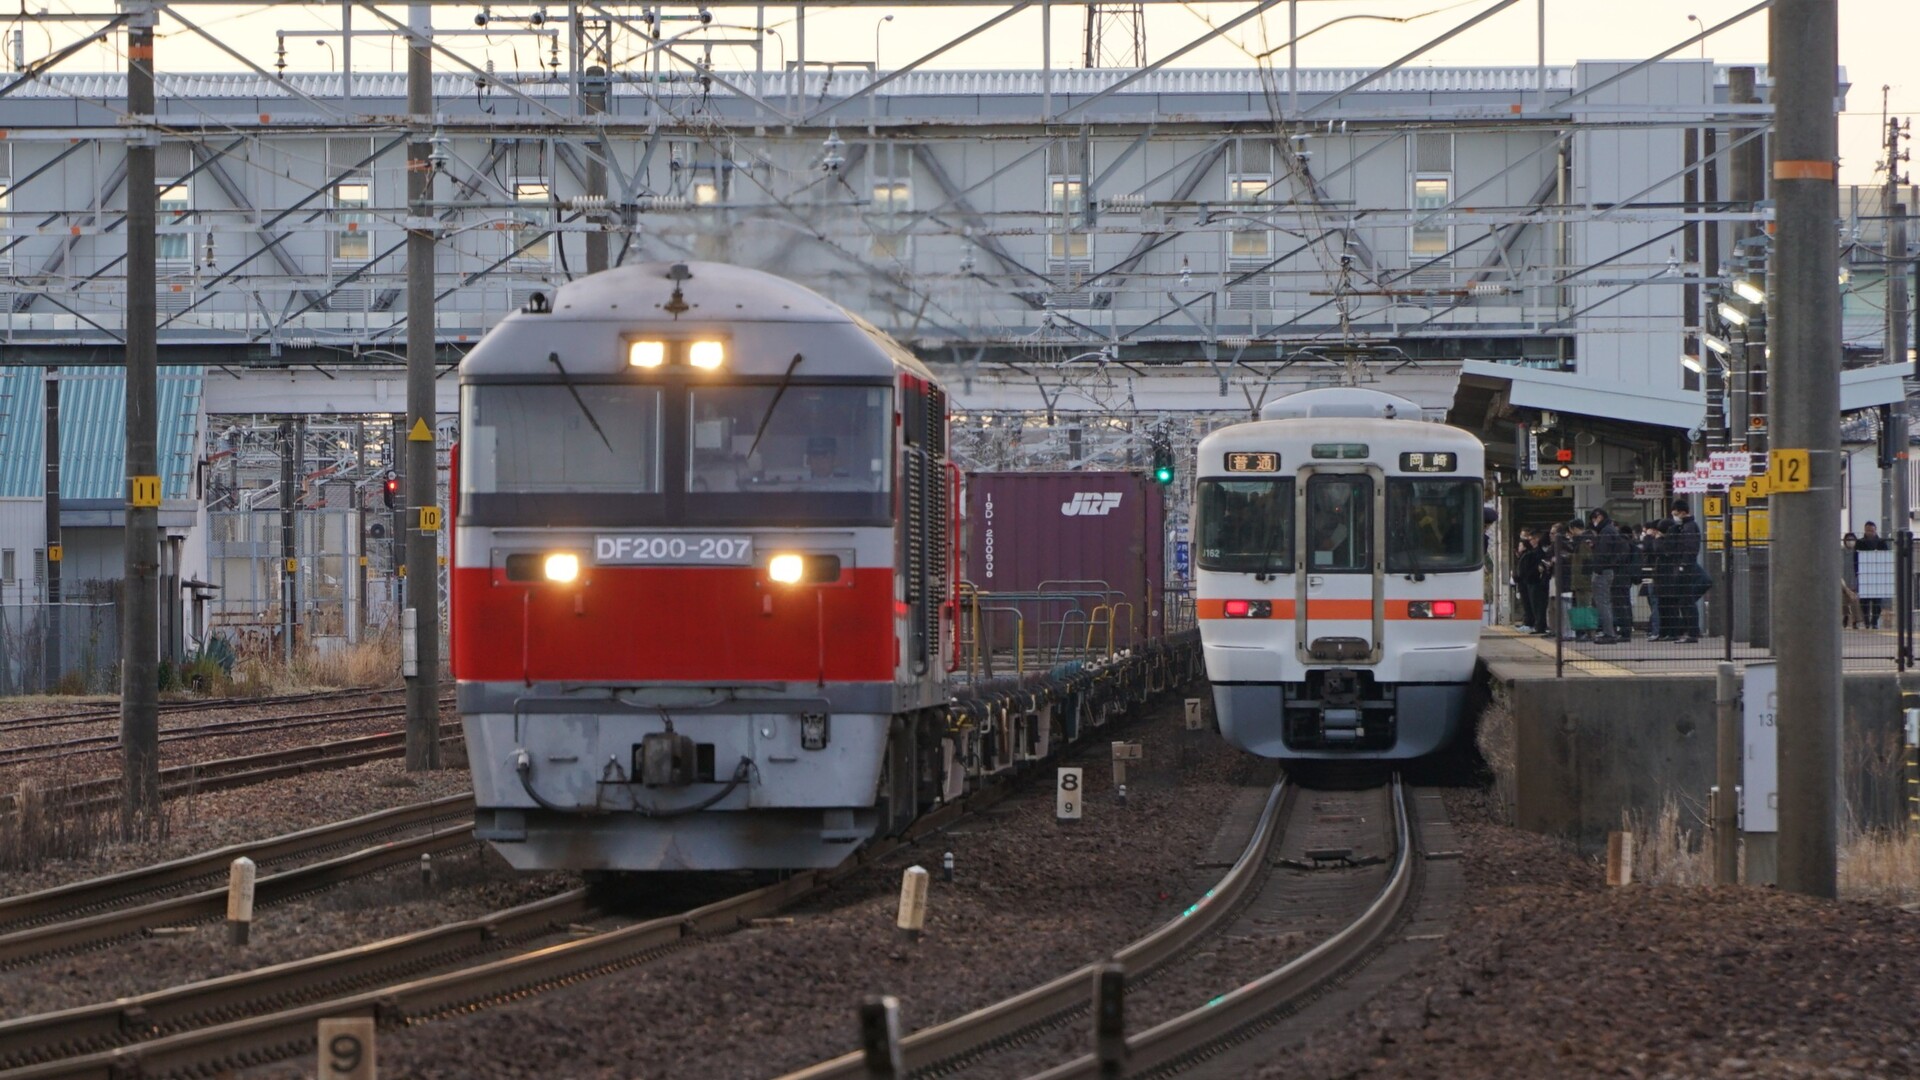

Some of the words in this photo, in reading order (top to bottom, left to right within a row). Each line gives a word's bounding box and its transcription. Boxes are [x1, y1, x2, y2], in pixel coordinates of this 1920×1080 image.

[1233, 455, 1273, 470] 普通
[1410, 453, 1447, 467] 岡崎
[1779, 458, 1799, 483] 12
[139, 482, 155, 500] 11
[1751, 481, 1758, 493] 9
[1735, 491, 1741, 502] 9
[1061, 492, 1123, 516] JRF
[1709, 501, 1715, 512] 8
[424, 511, 436, 525] 10
[53, 549, 58, 558] 7
[597, 538, 750, 559] DF200-207
[1187, 702, 1198, 714] 7
[1061, 773, 1078, 791] 8
[1065, 802, 1073, 813] 9
[329, 1034, 362, 1073] 9
